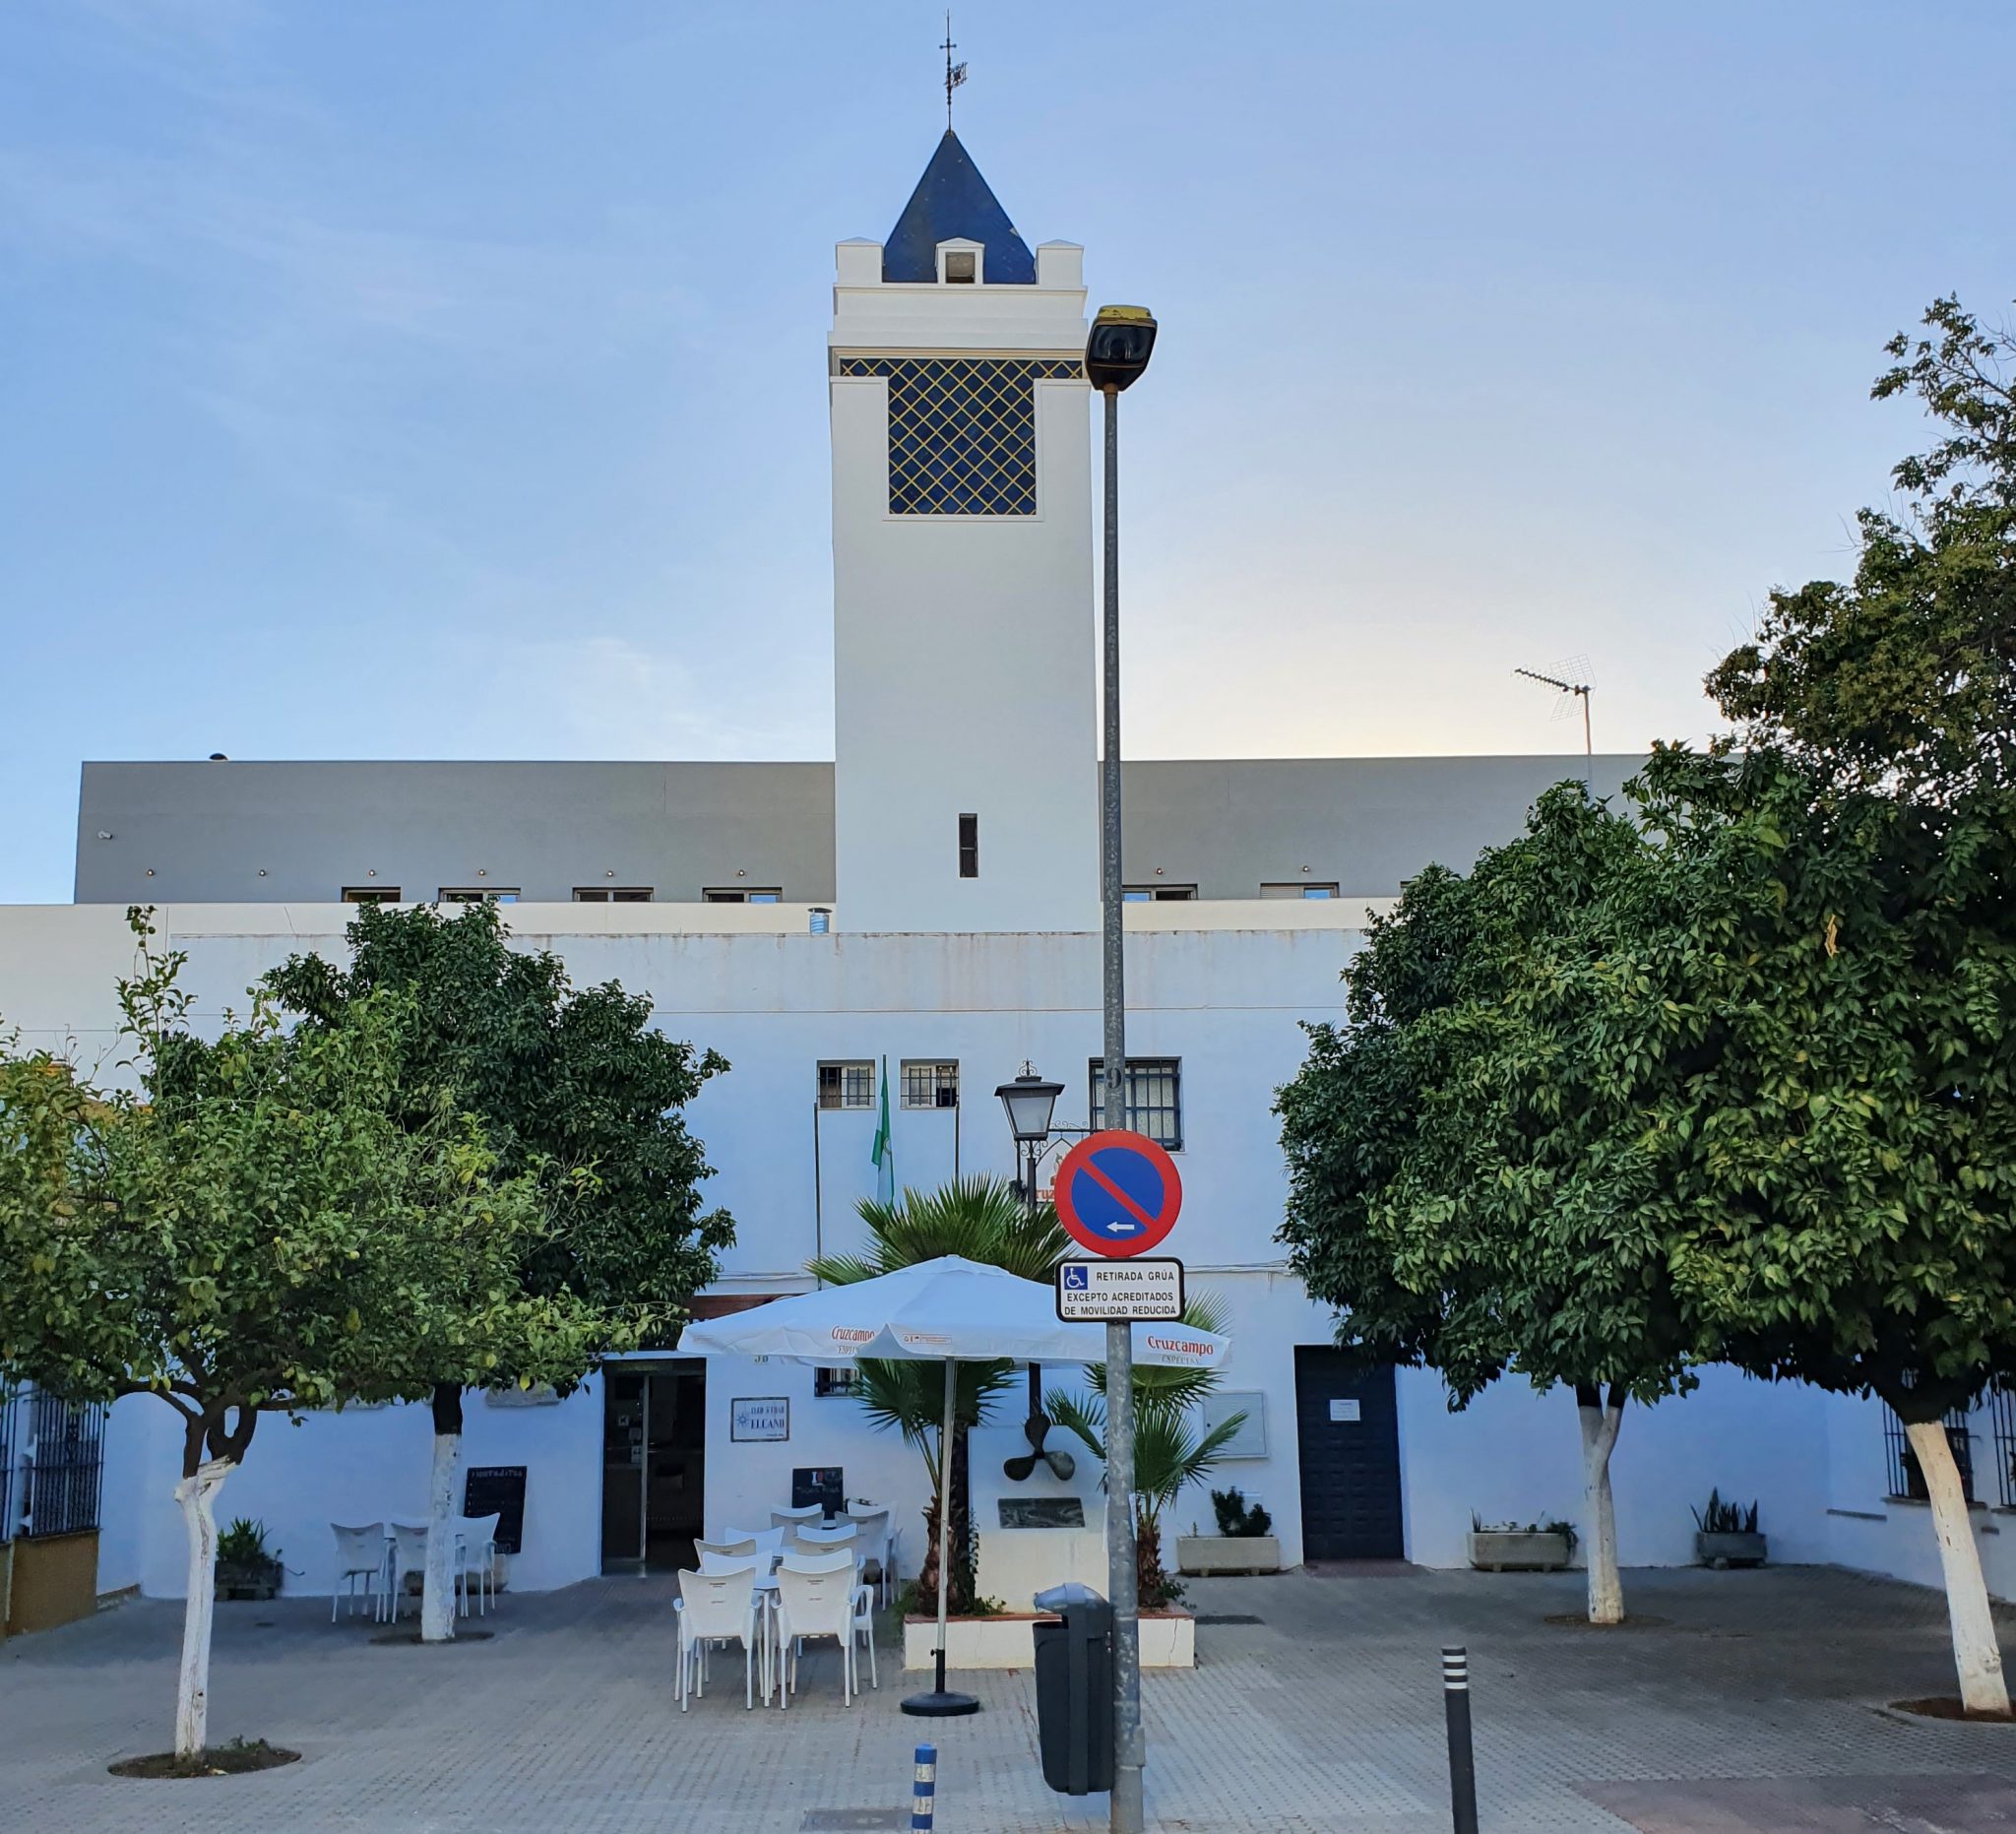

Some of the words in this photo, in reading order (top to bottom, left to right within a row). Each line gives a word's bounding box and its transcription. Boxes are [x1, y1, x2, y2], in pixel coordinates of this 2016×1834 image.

[1106, 1067, 1122, 1089] 9
[1096, 1271, 1143, 1281] RETIRADA
[1148, 1269, 1174, 1281] GRÚA
[1067, 1293, 1108, 1301] EXCEPTO
[1111, 1292, 1173, 1301] ACREDITADOS
[1064, 1306, 1076, 1315] DE
[1080, 1305, 1128, 1315] MOVILIDAD
[1132, 1305, 1176, 1314] REDUCIDA
[832, 1325, 875, 1342] Cruzcampo
[1147, 1335, 1214, 1357] Cruzcampo
[751, 1419, 785, 1429] ELCANO
